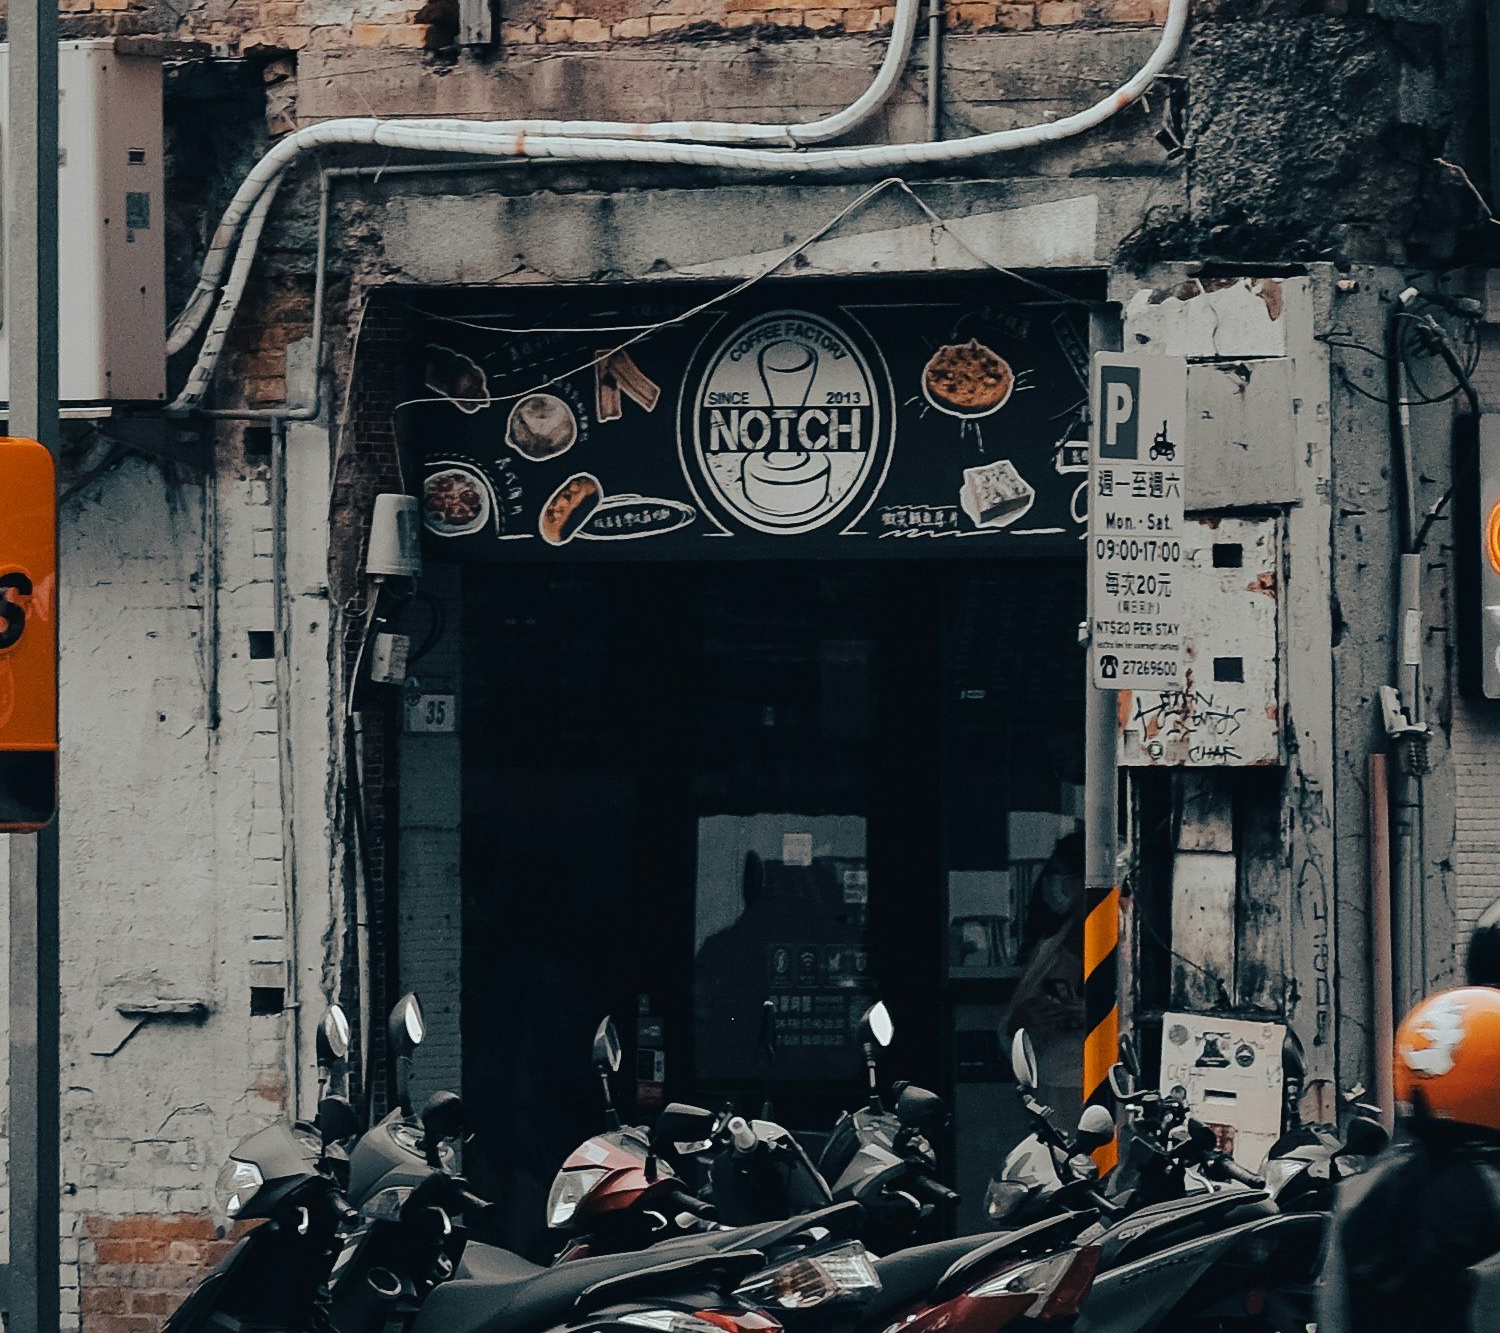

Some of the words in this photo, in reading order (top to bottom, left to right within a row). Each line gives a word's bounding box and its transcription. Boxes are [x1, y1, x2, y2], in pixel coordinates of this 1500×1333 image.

[730, 323, 784, 362] COFFEE
[784, 322, 848, 361] FACTORY
[708, 391, 750, 405] SINCE
[826, 391, 862, 404] 2013
[1107, 382, 1133, 445] P
[709, 409, 861, 450] NOTCH
[1098, 469, 1180, 500] 週一至週六
[1106, 571, 1172, 597] 每次20元
[1096, 621, 1130, 635] NT$20
[1134, 622, 1153, 636] PER
[1156, 622, 1180, 636] STAY
[425, 701, 446, 724] 35
